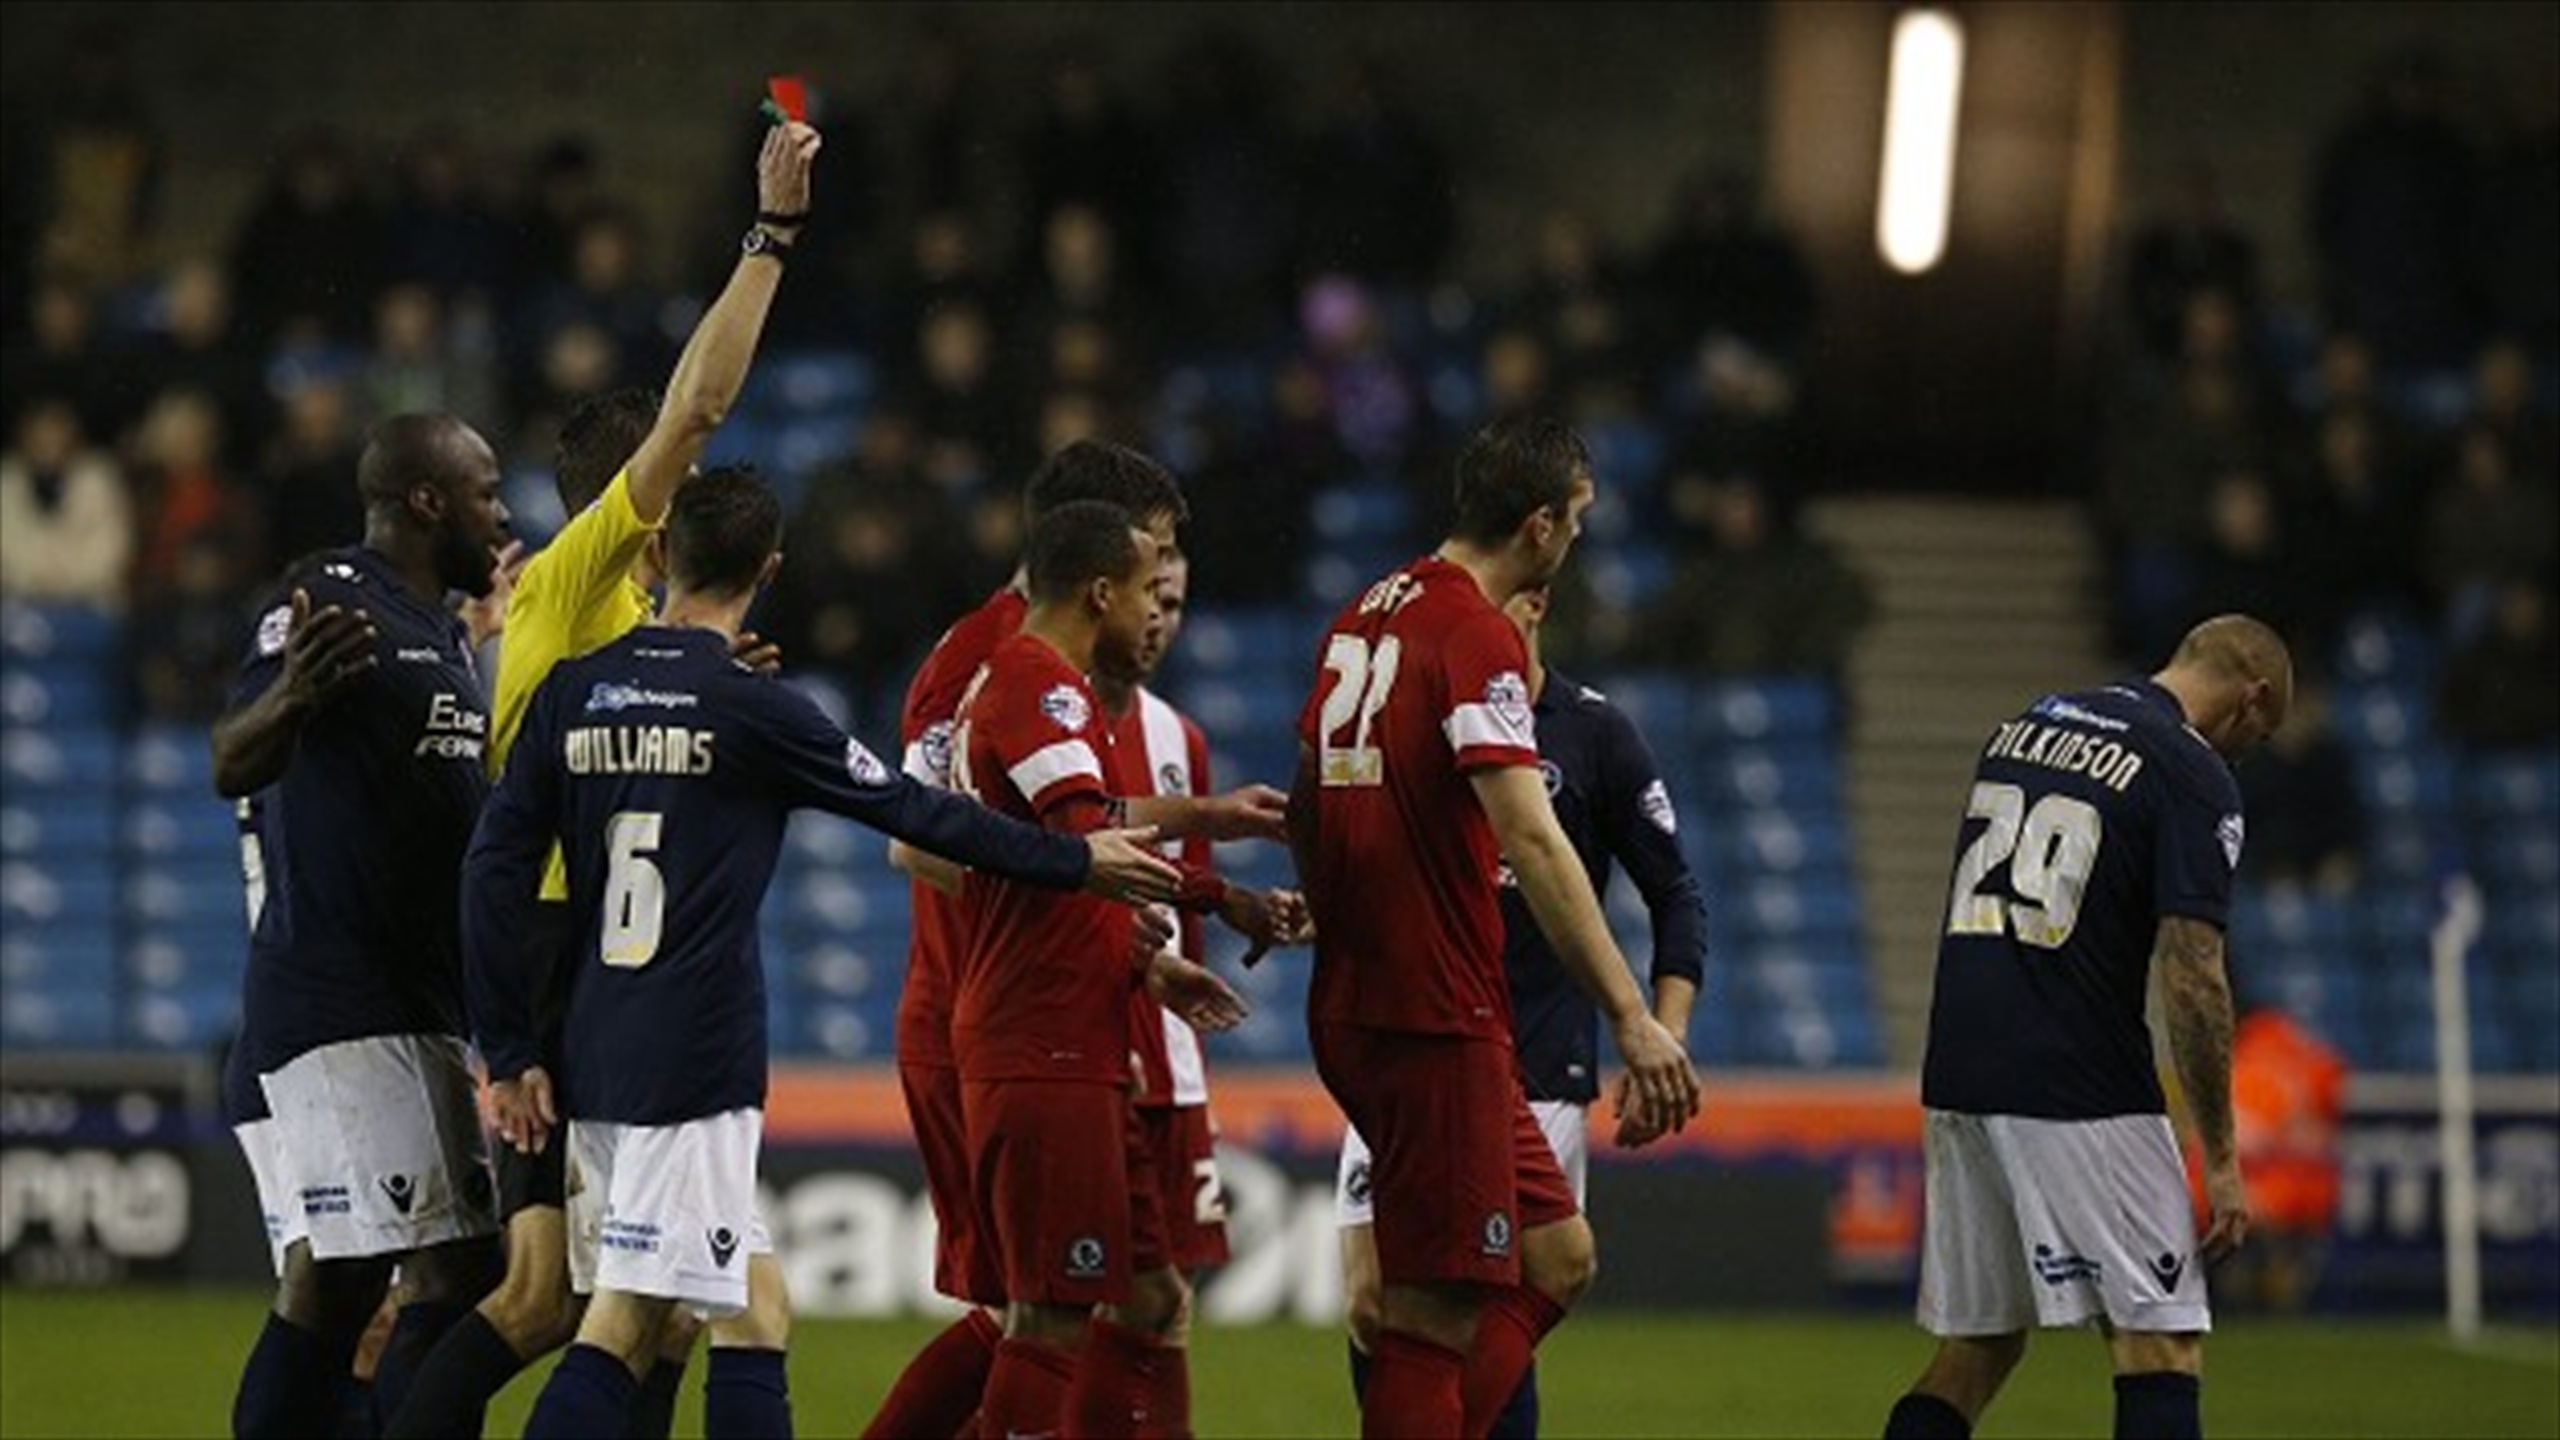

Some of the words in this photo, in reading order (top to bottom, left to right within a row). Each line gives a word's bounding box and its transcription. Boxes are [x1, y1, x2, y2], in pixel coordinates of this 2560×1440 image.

[565, 724, 715, 776] WILLIAMS
[600, 811, 666, 968] 6
[1946, 780, 2103, 949] 29
